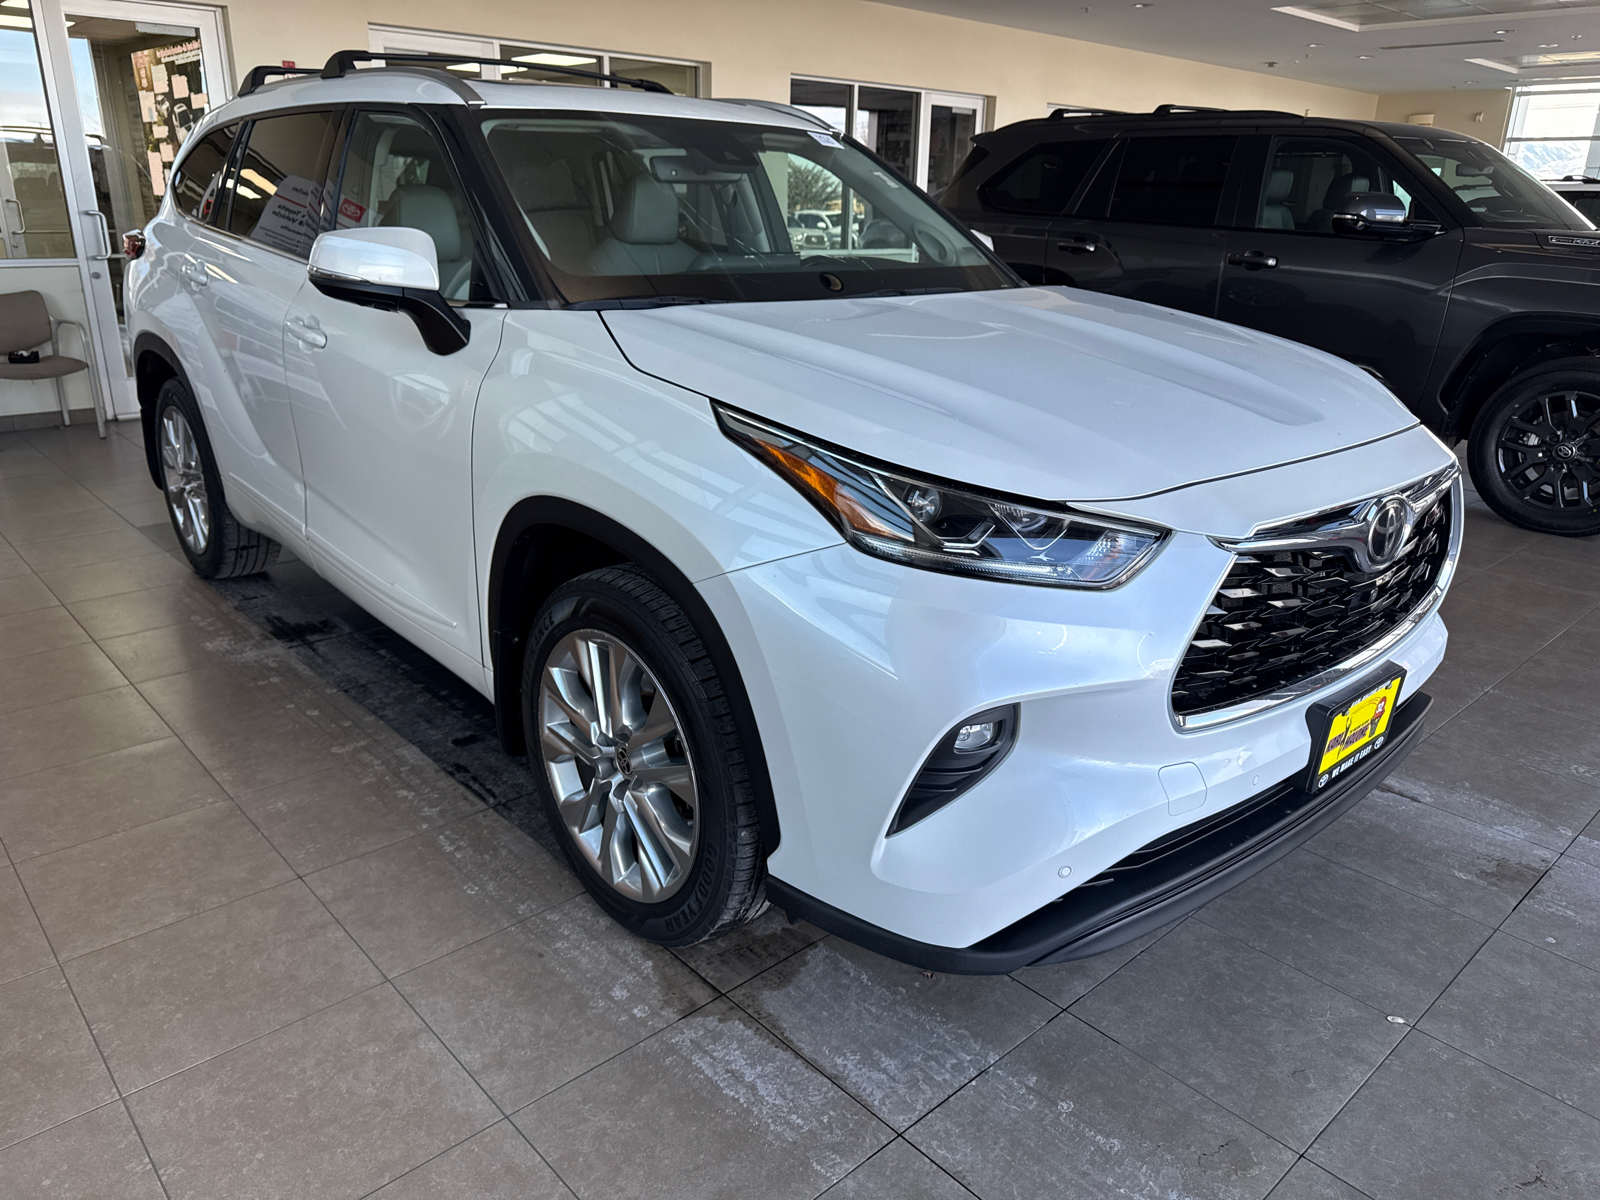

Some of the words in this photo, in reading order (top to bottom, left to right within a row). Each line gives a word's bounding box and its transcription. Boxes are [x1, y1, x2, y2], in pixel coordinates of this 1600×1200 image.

[1332, 767, 1340, 778] WE
[1341, 757, 1354, 772] MAKE
[1359, 745, 1372, 758] EASY
[664, 841, 717, 933] GOODYEAR
